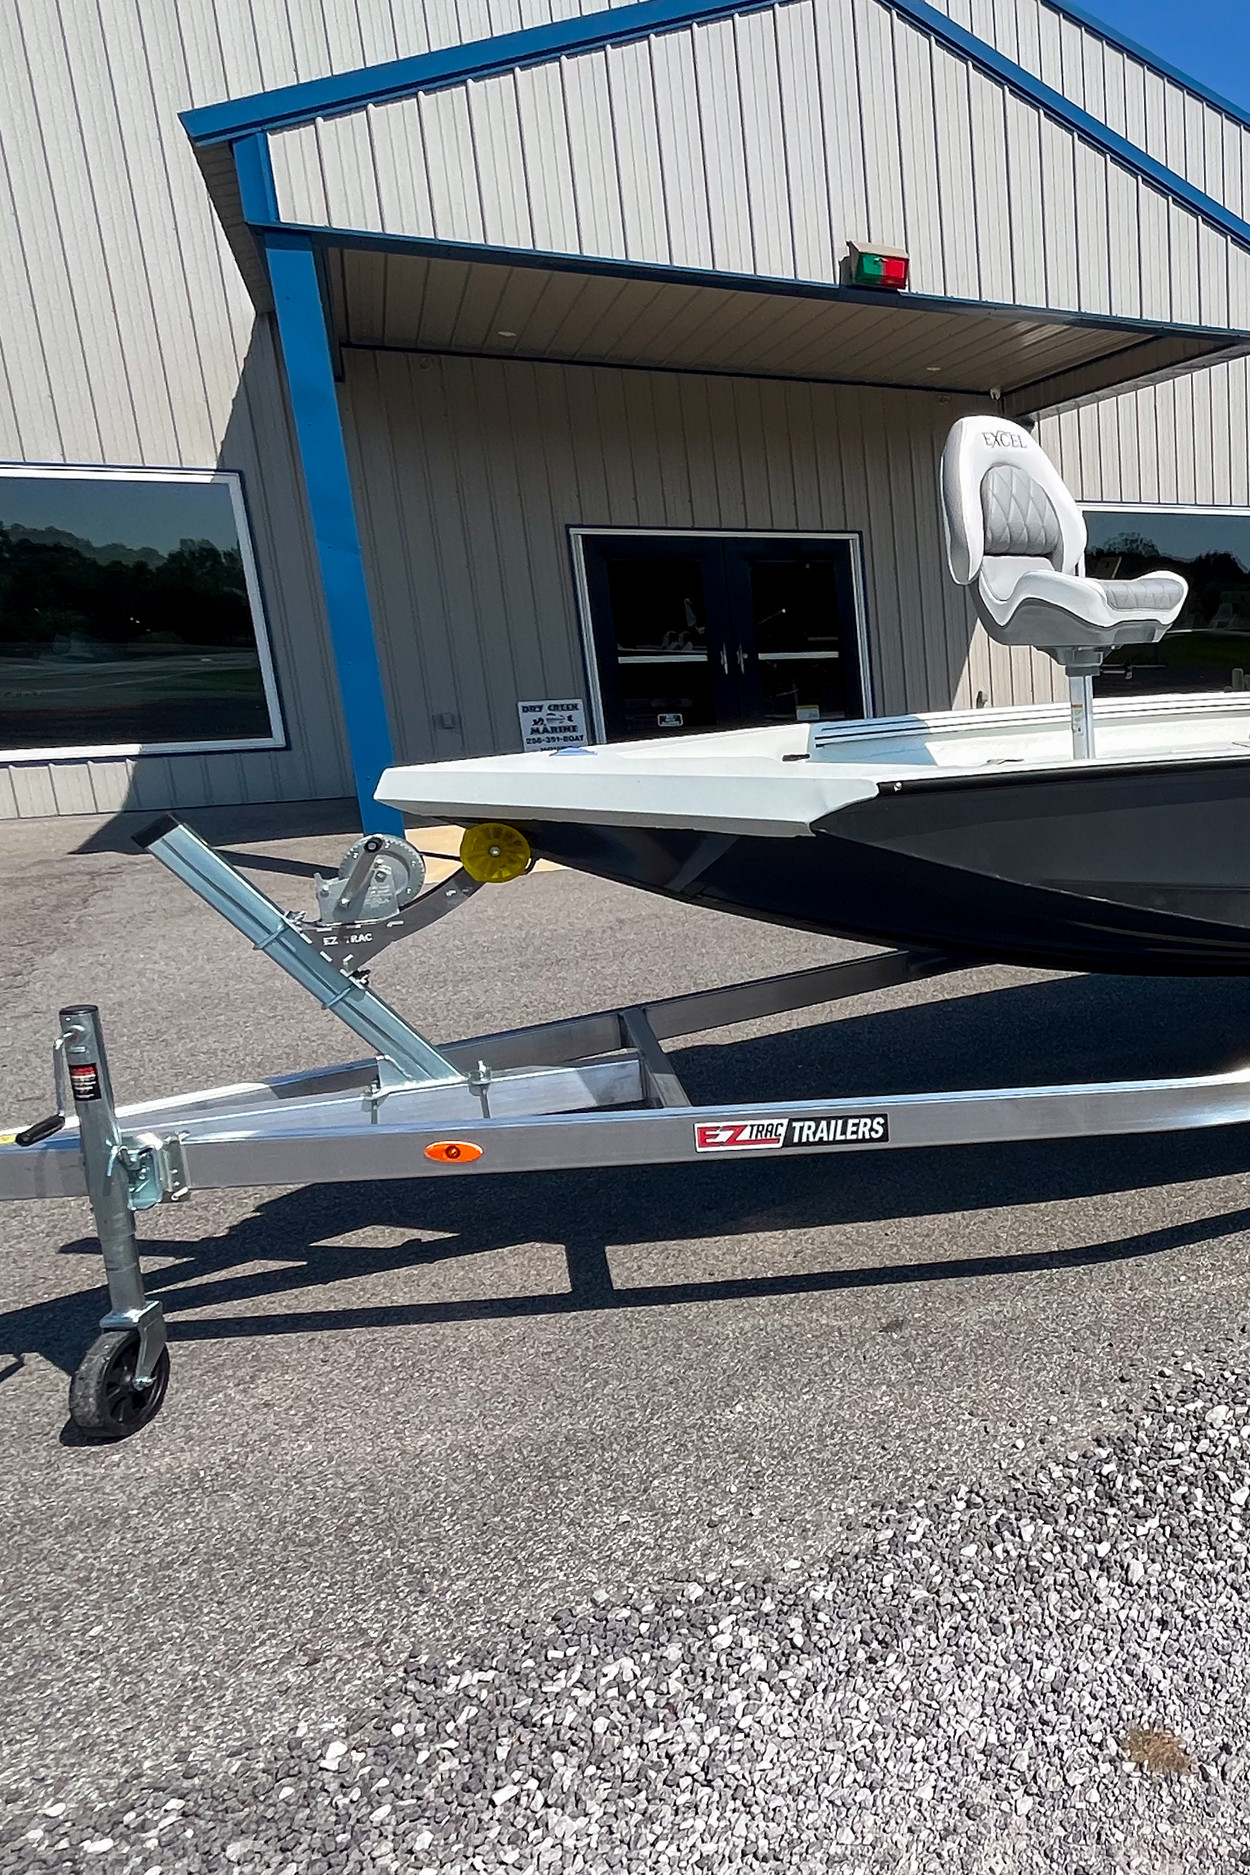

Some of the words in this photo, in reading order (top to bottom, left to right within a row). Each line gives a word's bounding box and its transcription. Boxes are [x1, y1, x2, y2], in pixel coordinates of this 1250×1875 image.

[981, 430, 1027, 449] EXCEL
[521, 704, 543, 713] DRY
[547, 703, 579, 711] CREEK
[530, 724, 578, 735] MARINE
[323, 936, 339, 946] EZ
[697, 1125, 748, 1148] EZ
[750, 1123, 784, 1139] TRAC
[792, 1117, 885, 1143] TRAILERS
